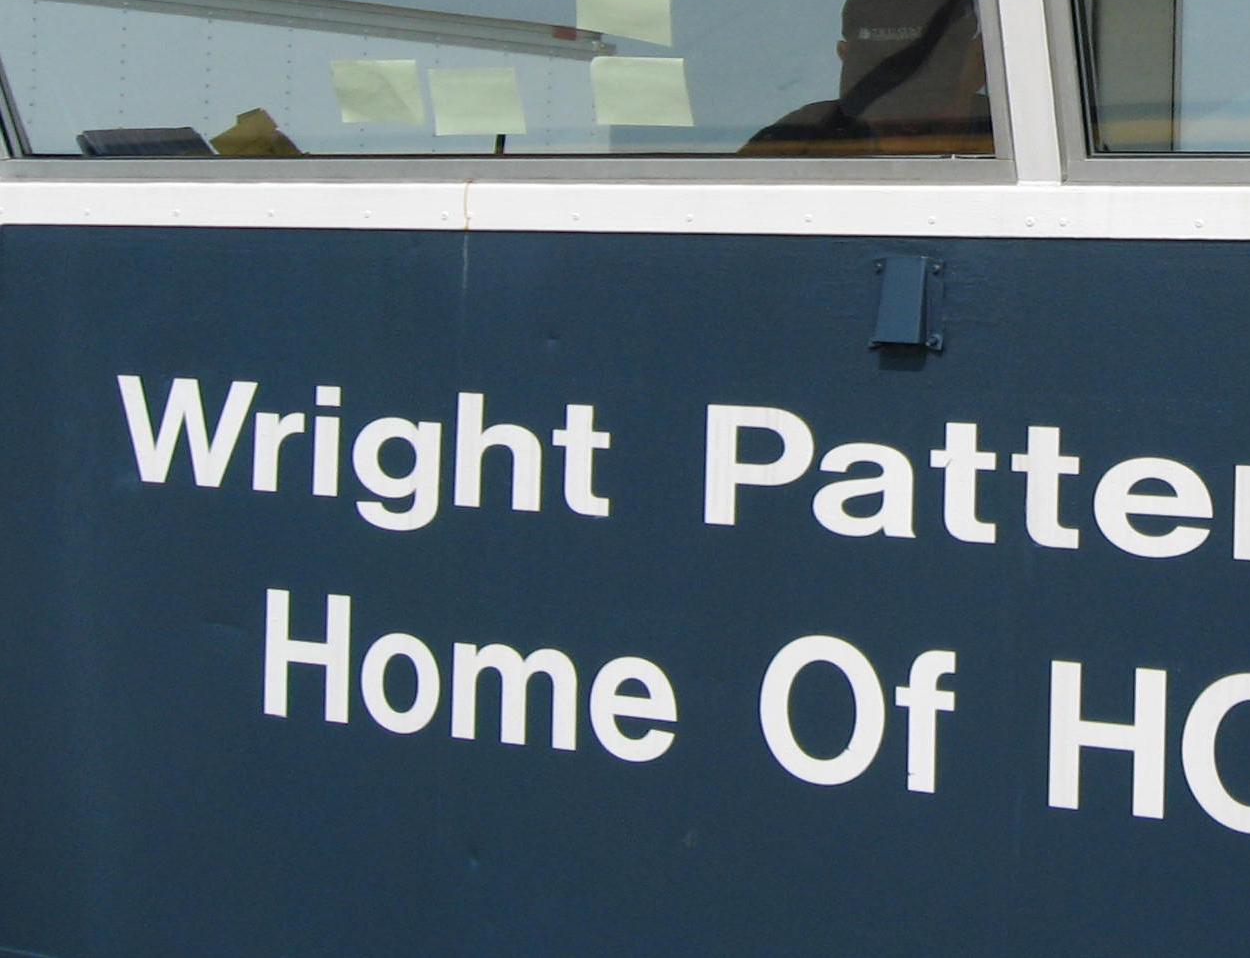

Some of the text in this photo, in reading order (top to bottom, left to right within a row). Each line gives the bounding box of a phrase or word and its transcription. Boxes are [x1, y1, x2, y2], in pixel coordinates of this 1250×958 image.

[117, 374, 611, 531] Wright
[263, 588, 678, 762] Home
[759, 634, 956, 794] Of
